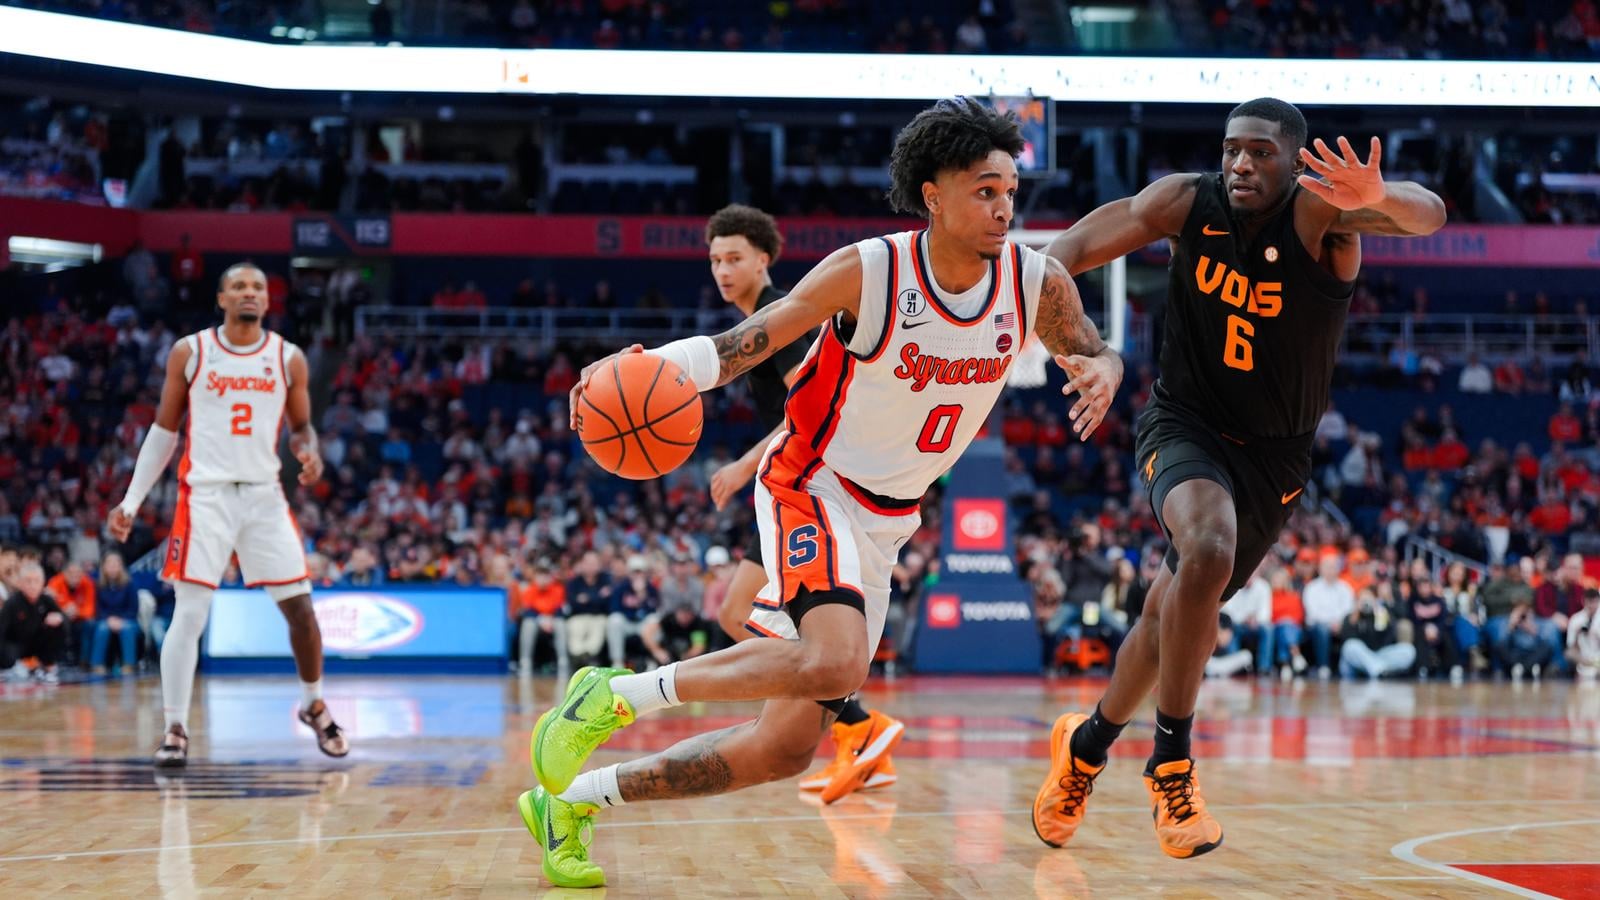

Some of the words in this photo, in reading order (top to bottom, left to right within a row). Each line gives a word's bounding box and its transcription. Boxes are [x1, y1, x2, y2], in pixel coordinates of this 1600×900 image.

[355, 219, 388, 243] 113
[906, 301, 917, 313] 21
[907, 292, 917, 301] LM
[1223, 313, 1255, 372] 6
[206, 370, 276, 397] Syracuse
[231, 402, 252, 436] 2
[916, 404, 964, 454] 0
[788, 523, 819, 569] S
[946, 553, 1014, 573] TOYOTA
[961, 601, 1031, 622] TOYOTA
